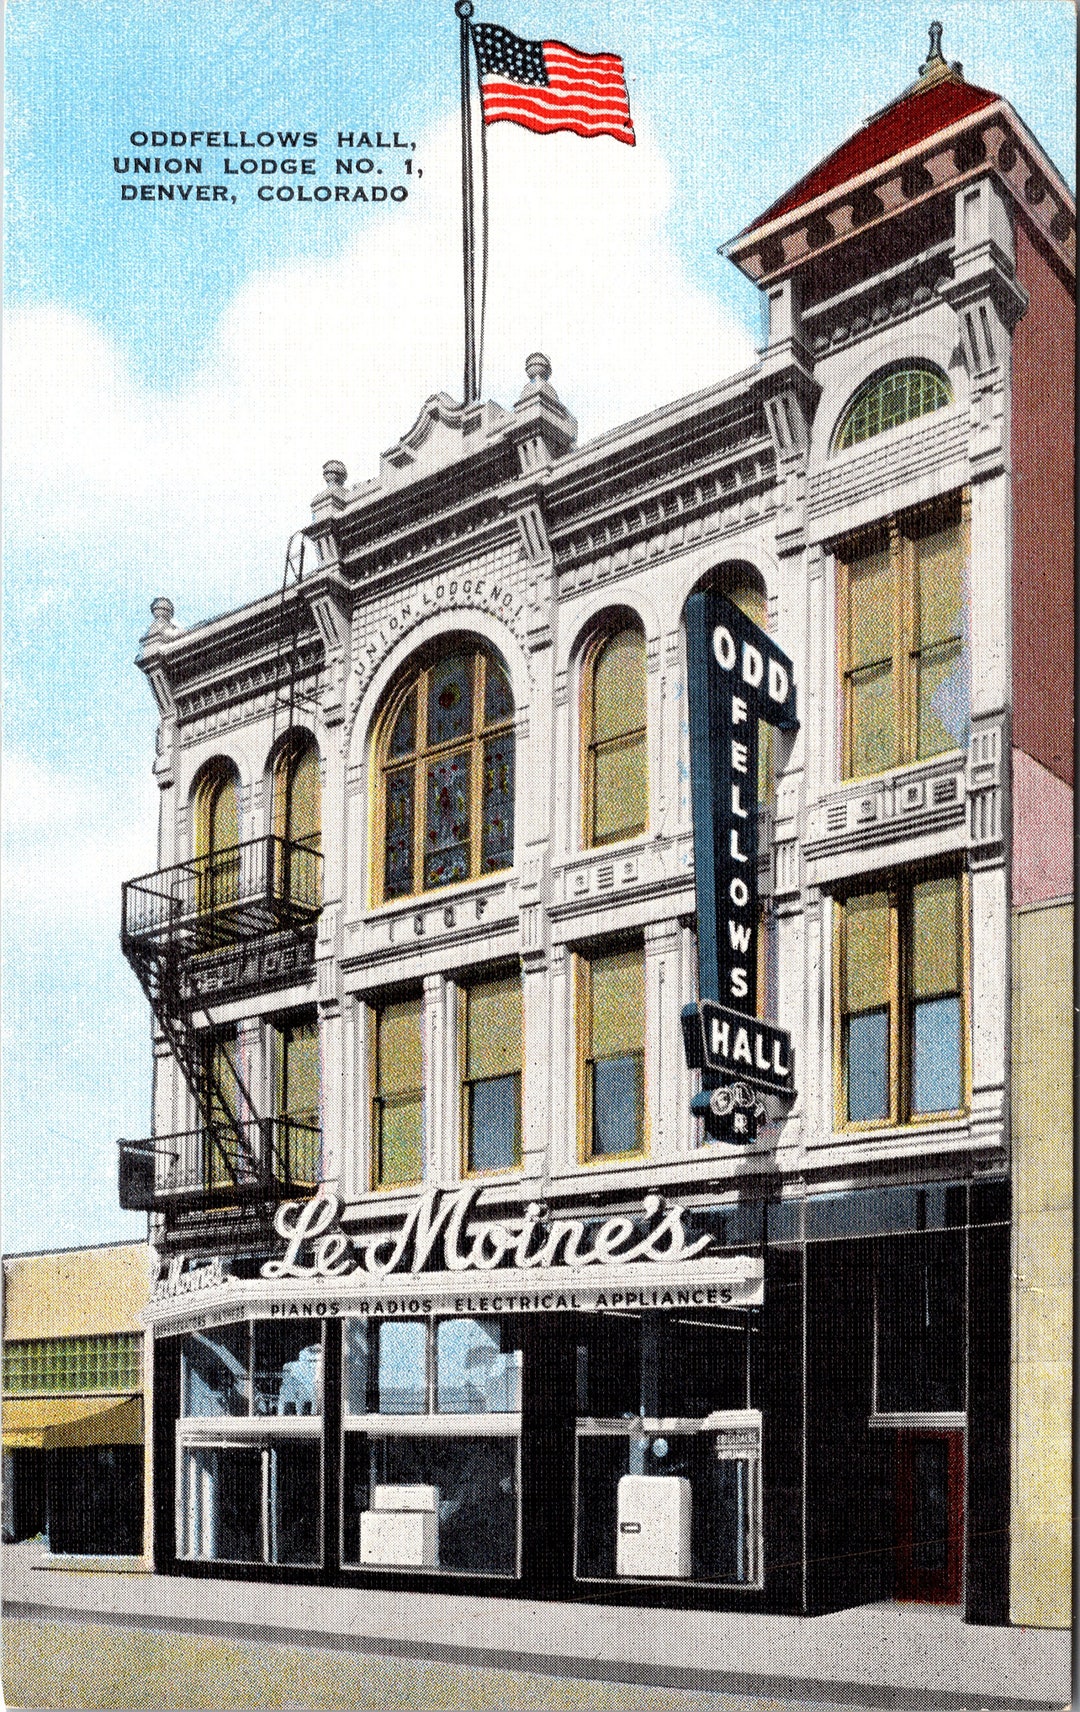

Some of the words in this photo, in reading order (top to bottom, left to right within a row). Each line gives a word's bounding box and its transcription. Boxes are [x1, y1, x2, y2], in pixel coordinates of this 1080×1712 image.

[354, 604, 411, 677] UNION
[423, 580, 486, 605] LODGE
[713, 625, 789, 703] ODD
[728, 695, 751, 998] FELLOWS
[712, 1018, 789, 1076] HALL
[271, 1303, 340, 1318] PIANOS
[360, 1299, 433, 1315] RADIOS
[454, 1294, 581, 1312] ELECTRICAL
[595, 1288, 733, 1308] APPLIANCES
